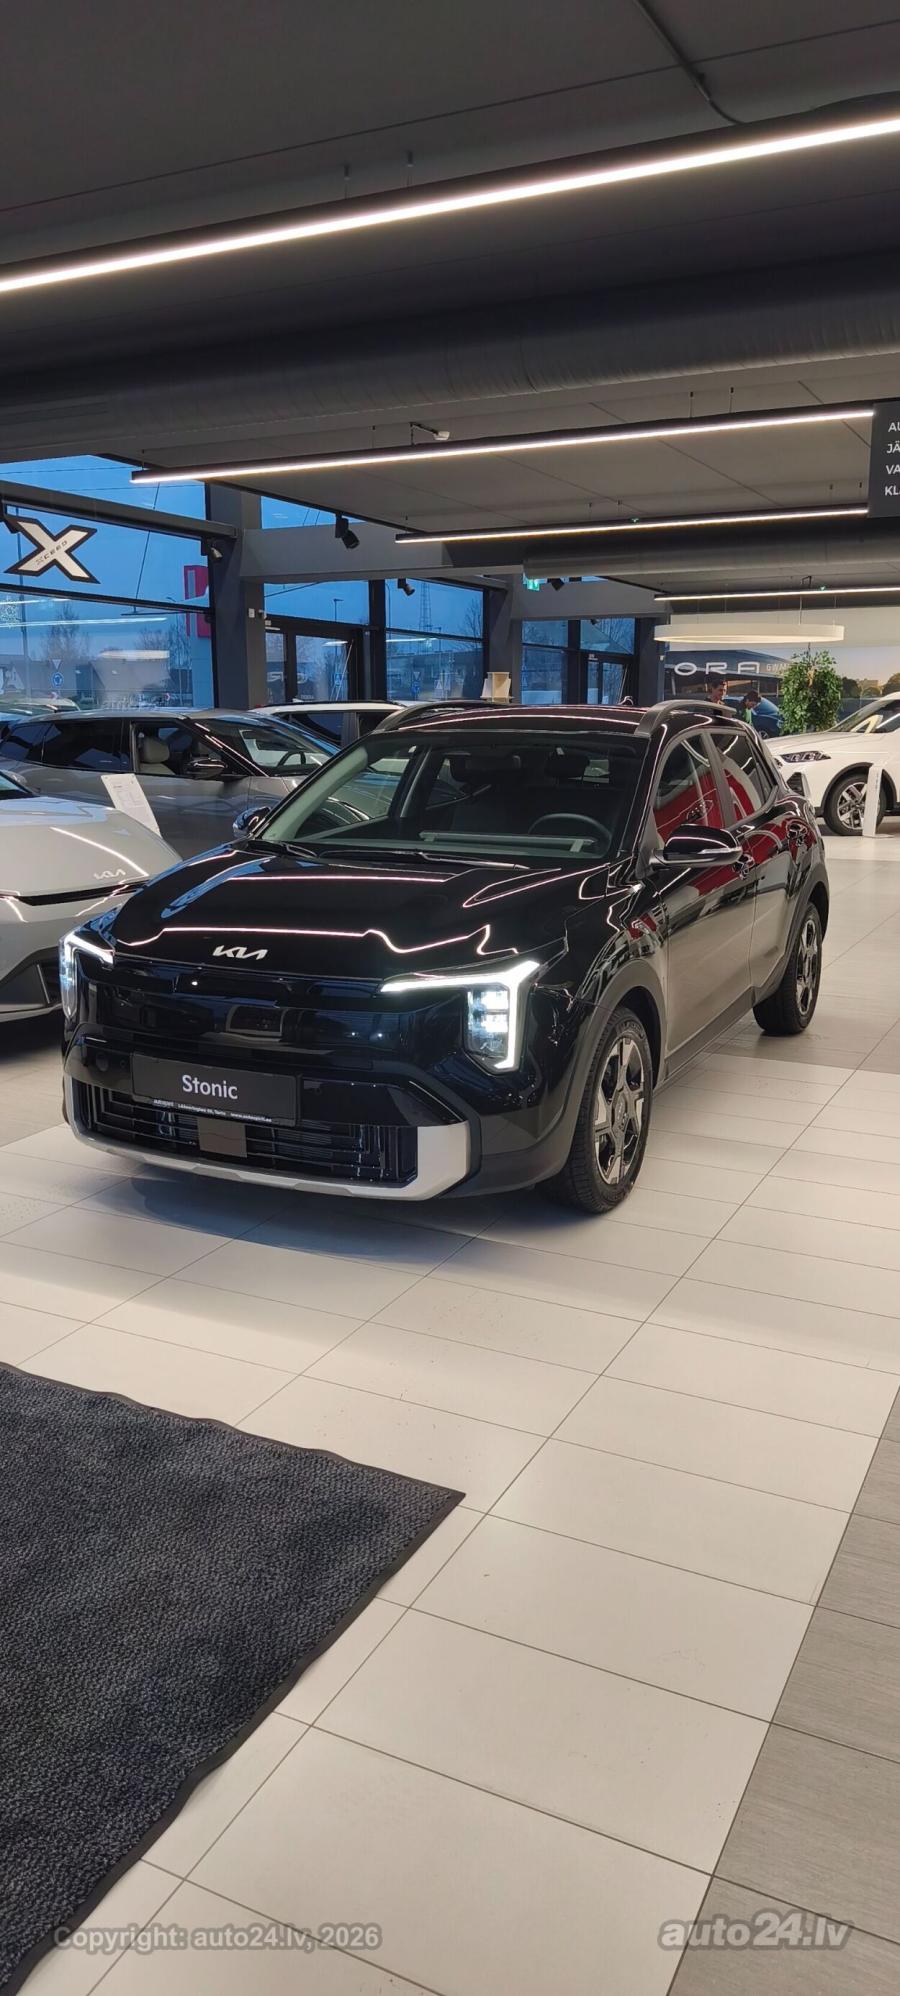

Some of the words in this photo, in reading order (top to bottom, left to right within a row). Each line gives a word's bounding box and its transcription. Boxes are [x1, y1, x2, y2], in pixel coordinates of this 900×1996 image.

[884, 485, 900, 496] KL
[674, 662, 760, 676] ORA
[212, 945, 268, 960] KIA
[182, 1074, 238, 1100] Stonic
